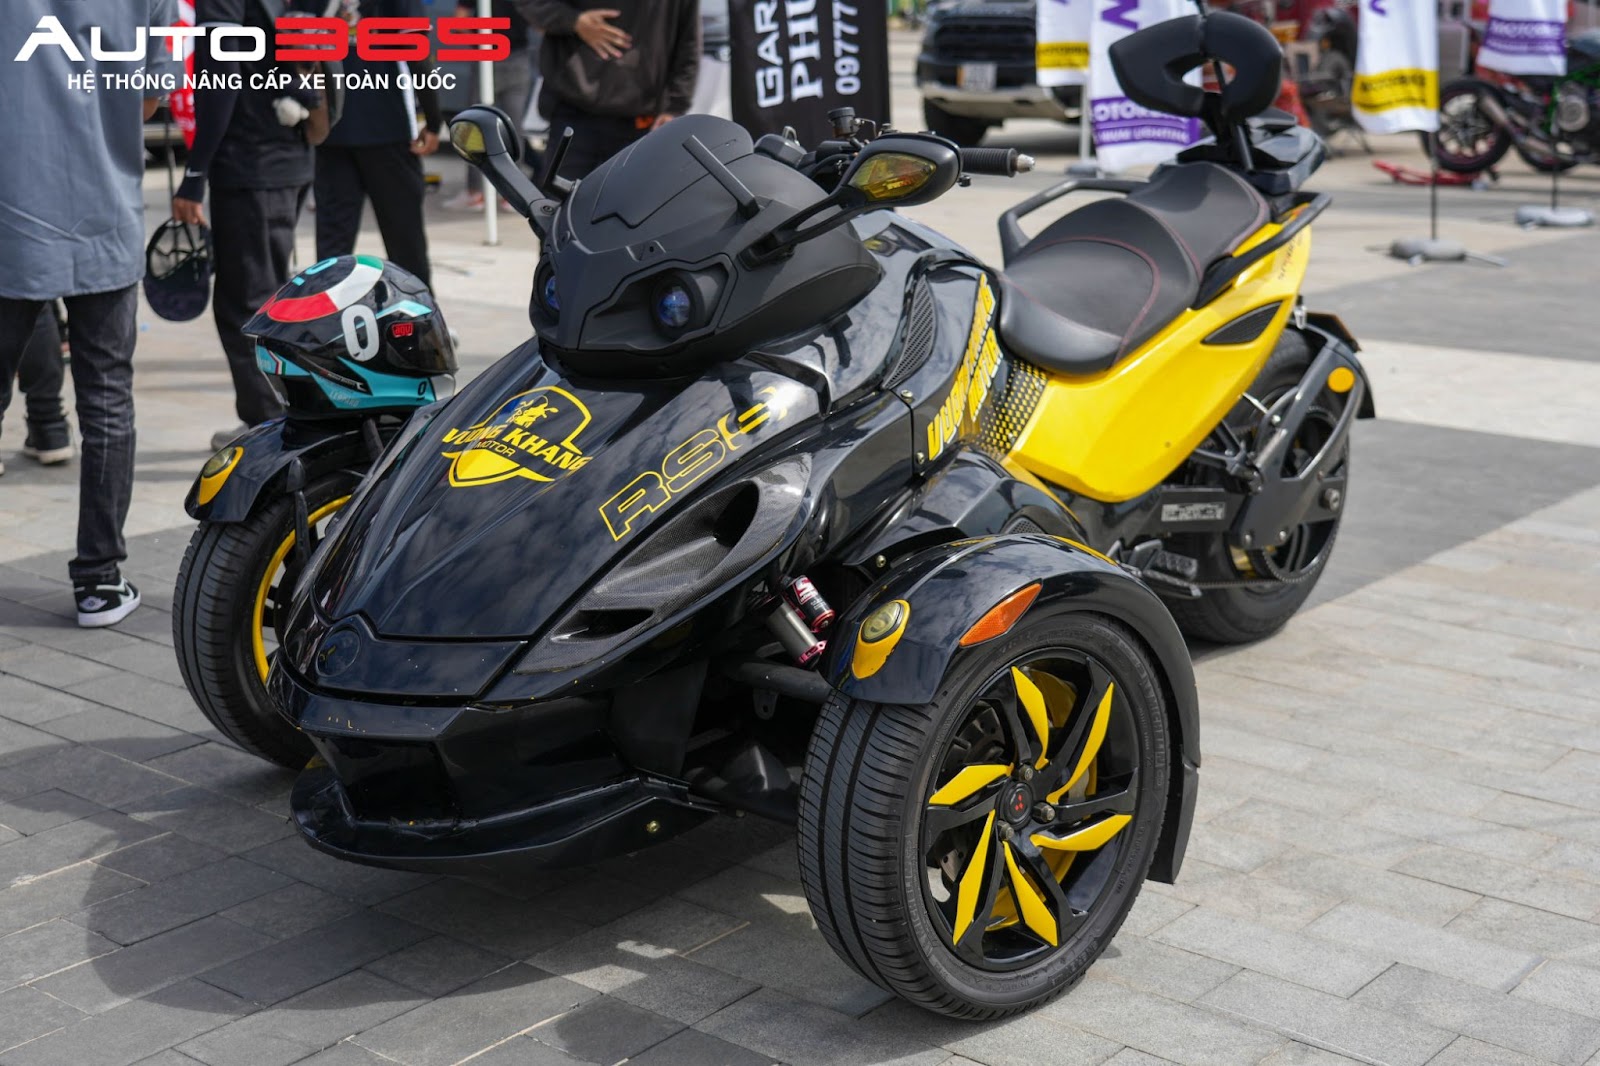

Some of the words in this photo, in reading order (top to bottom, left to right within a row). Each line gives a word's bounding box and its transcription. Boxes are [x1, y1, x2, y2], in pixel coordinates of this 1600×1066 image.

[754, 0, 784, 108] GAR
[832, 0, 861, 95] 09777
[501, 427, 593, 471] KHANG
